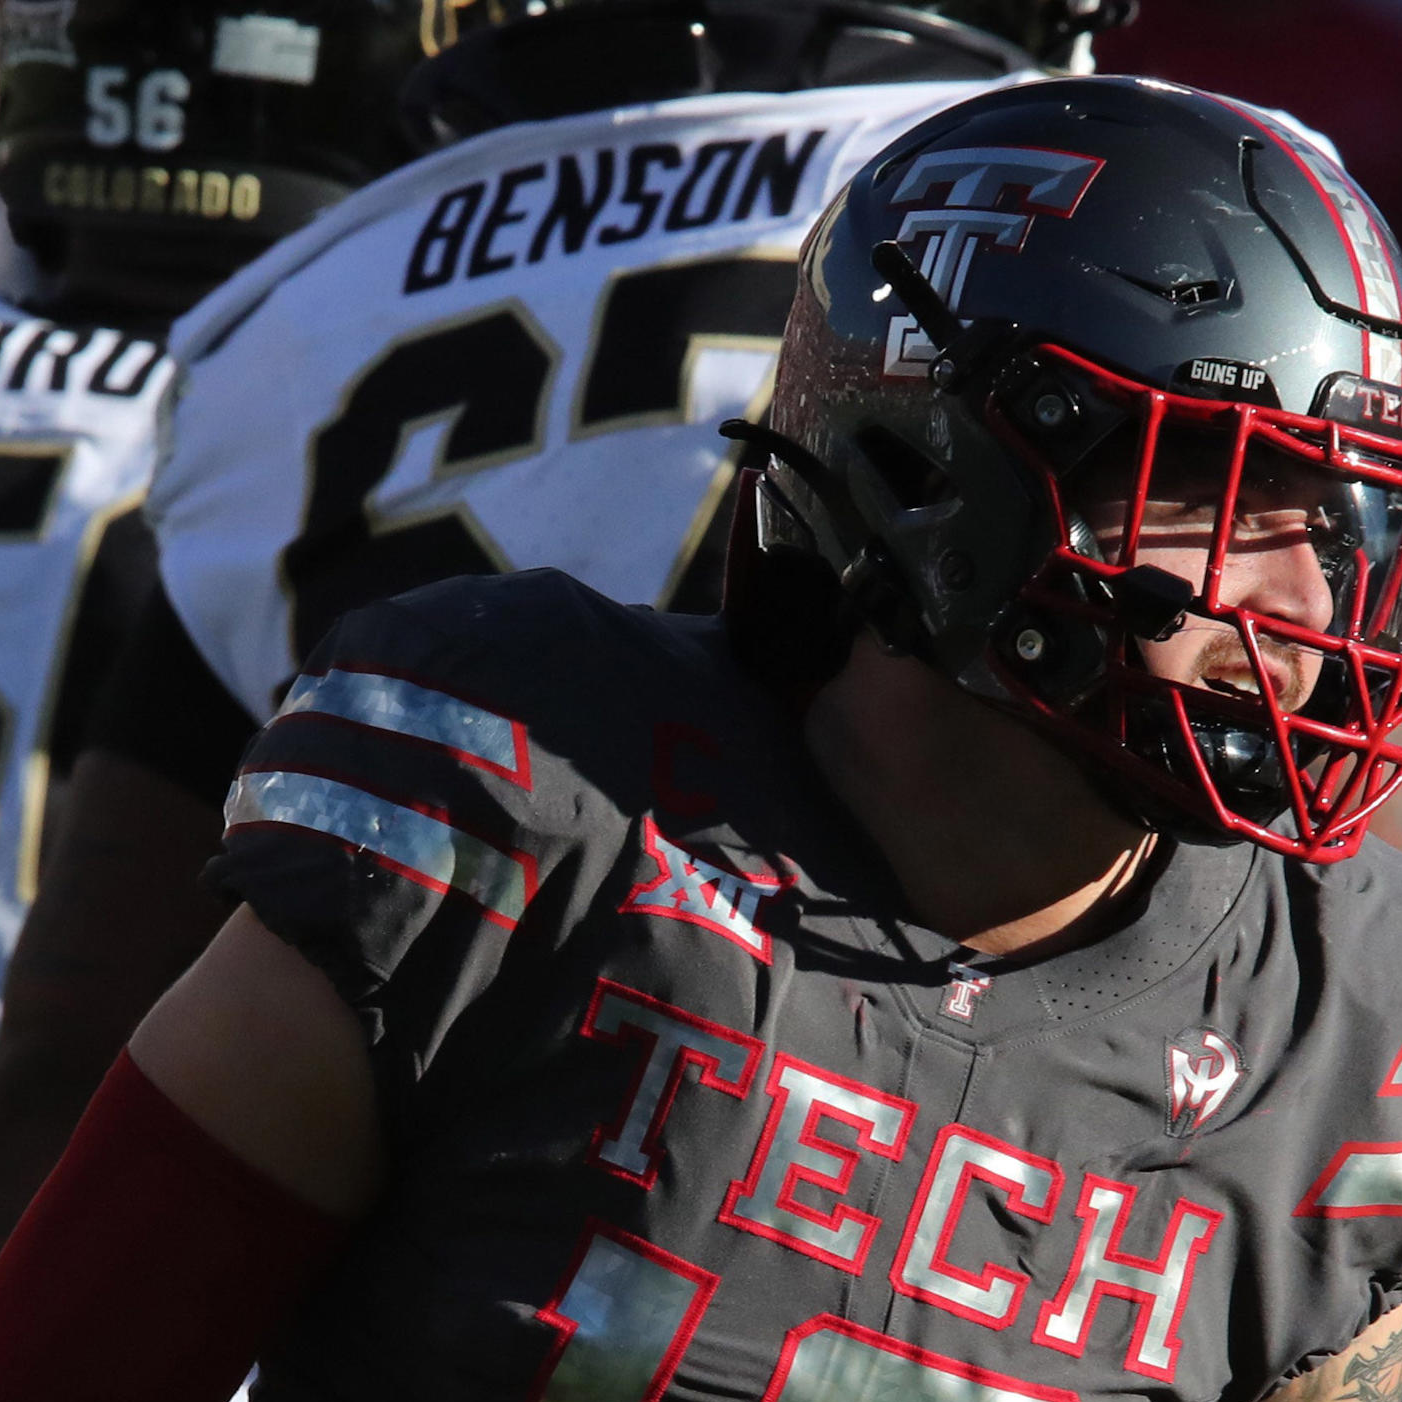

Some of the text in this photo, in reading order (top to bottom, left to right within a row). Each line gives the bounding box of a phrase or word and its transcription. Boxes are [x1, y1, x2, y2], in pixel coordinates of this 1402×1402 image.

[84, 65, 192, 151] 56
[43, 162, 262, 221] COLORADO
[402, 129, 827, 295] BENSON
[1190, 359, 1267, 391] GUNS UP
[579, 976, 1226, 1385] TECH
